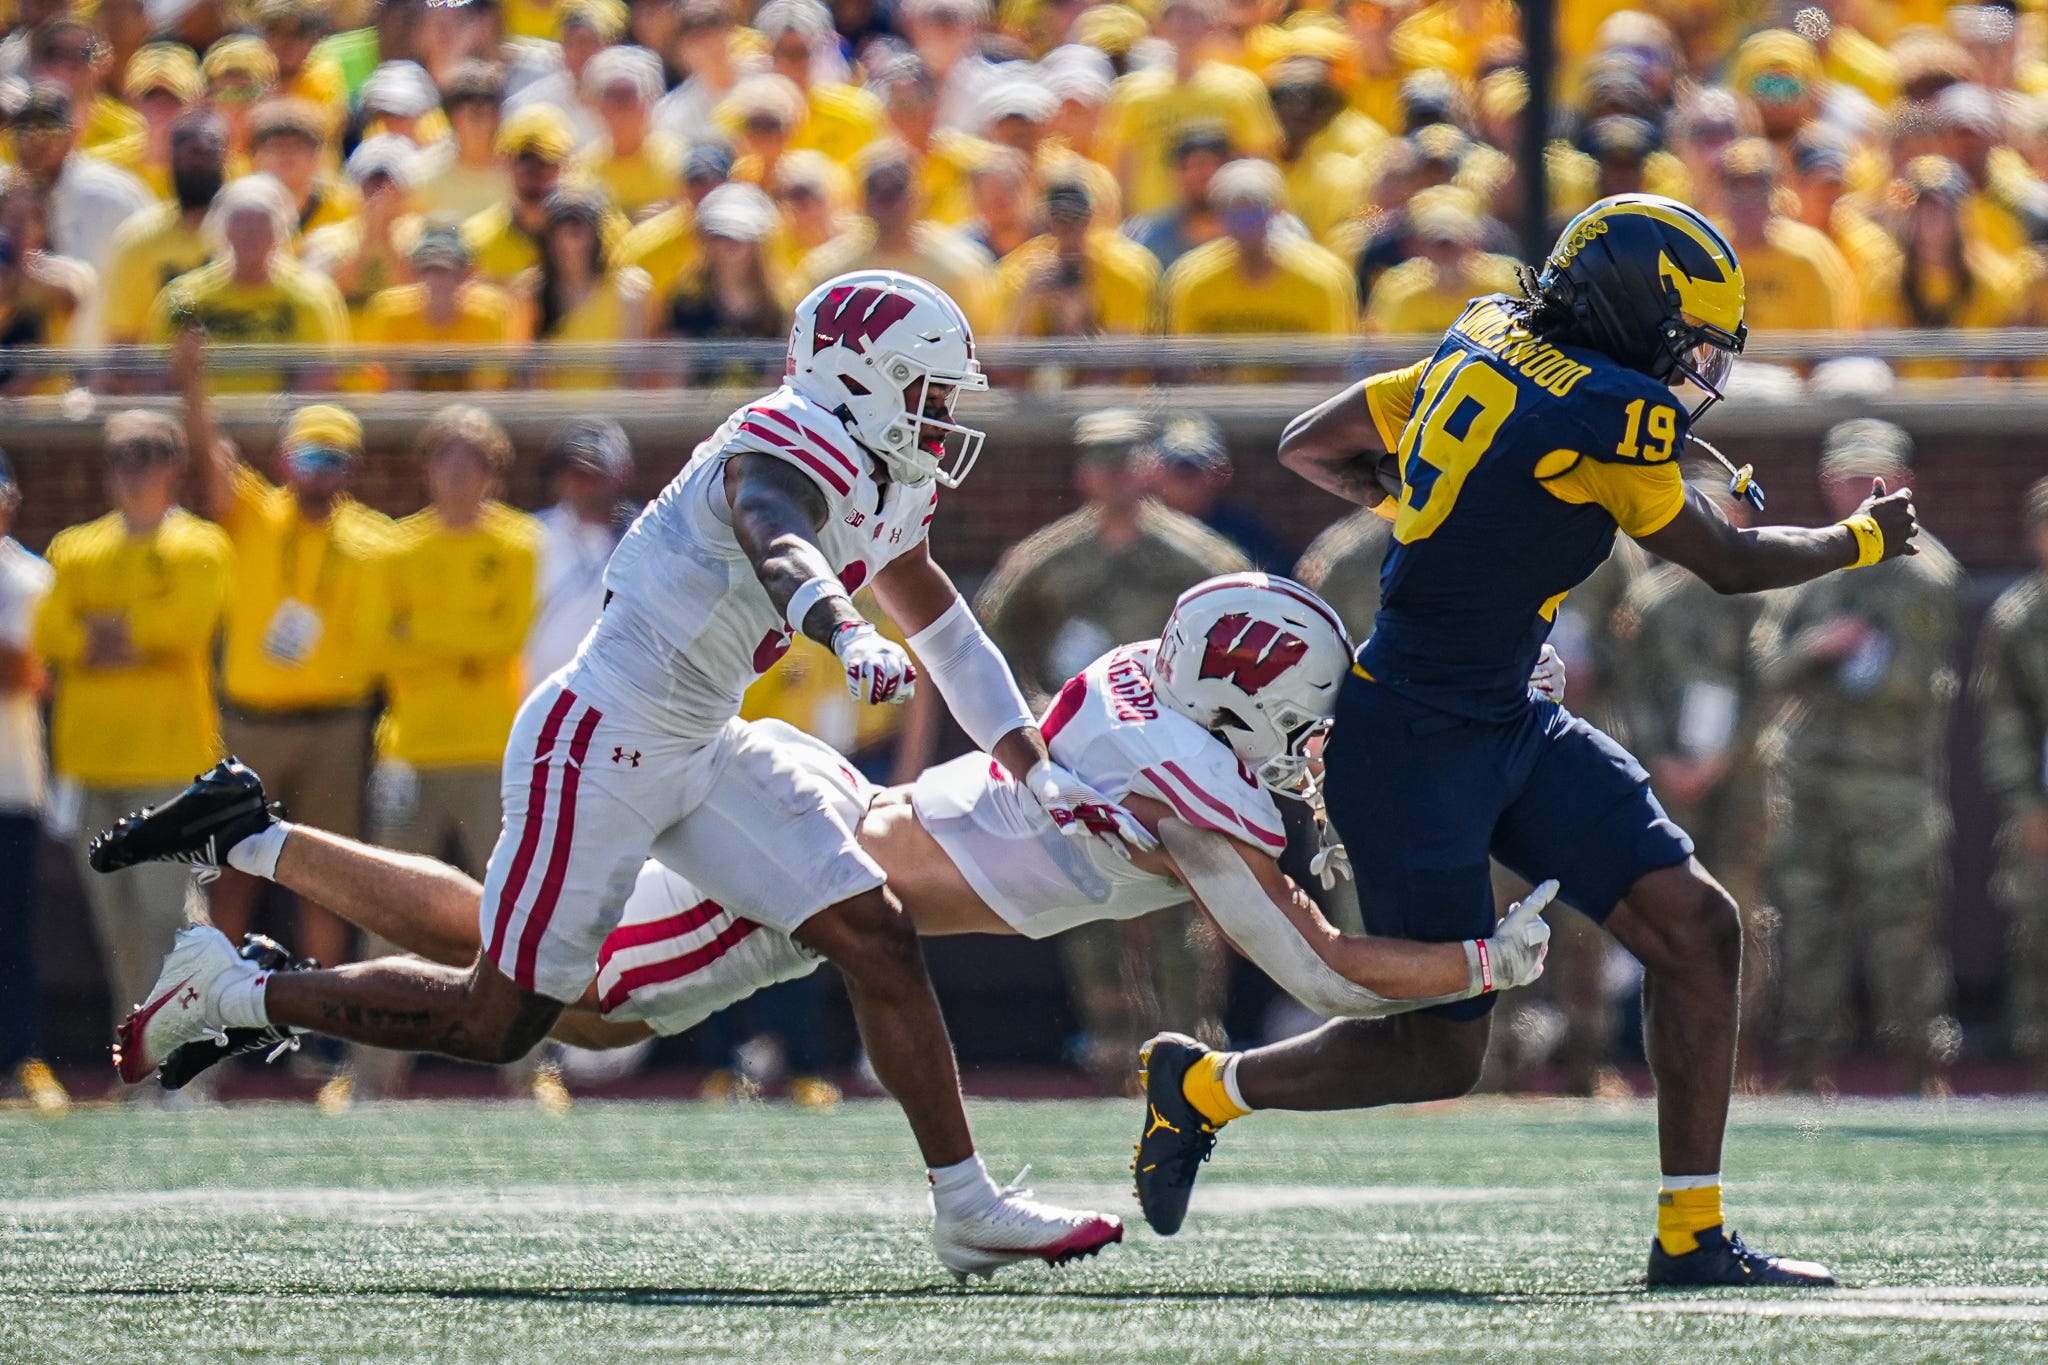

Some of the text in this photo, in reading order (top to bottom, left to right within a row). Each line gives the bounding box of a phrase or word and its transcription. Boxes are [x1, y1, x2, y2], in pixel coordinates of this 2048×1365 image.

[814, 286, 916, 357] W
[1392, 349, 1518, 545] 19
[1616, 398, 1676, 462] 19
[1198, 611, 1309, 697] W
